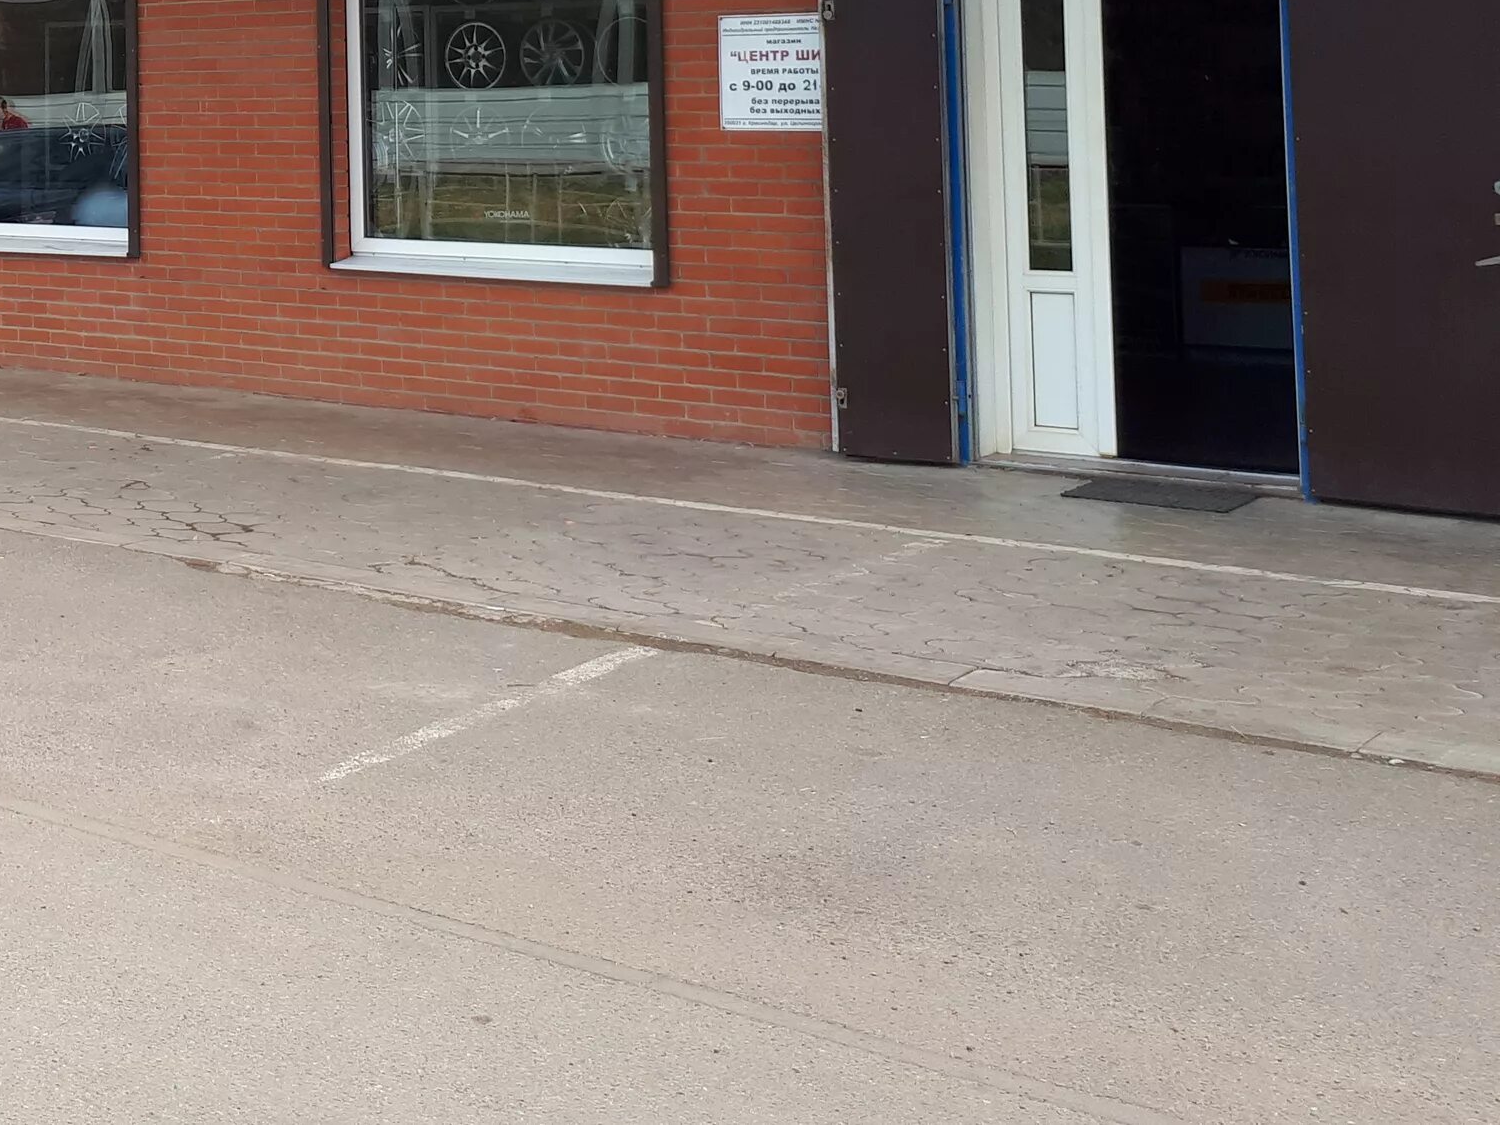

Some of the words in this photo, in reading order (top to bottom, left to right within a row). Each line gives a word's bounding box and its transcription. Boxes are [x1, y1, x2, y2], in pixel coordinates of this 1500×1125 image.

[750, 67, 780, 75] ВРЕМЯ
[782, 67, 819, 75] РАБОТЫ
[742, 80, 773, 91] 9-00
[777, 82, 796, 93] до
[751, 97, 769, 105] без
[771, 98, 820, 106] перерыва
[749, 106, 767, 114] без
[770, 107, 820, 115] выходных
[483, 210, 530, 218] YOKOHAMA
